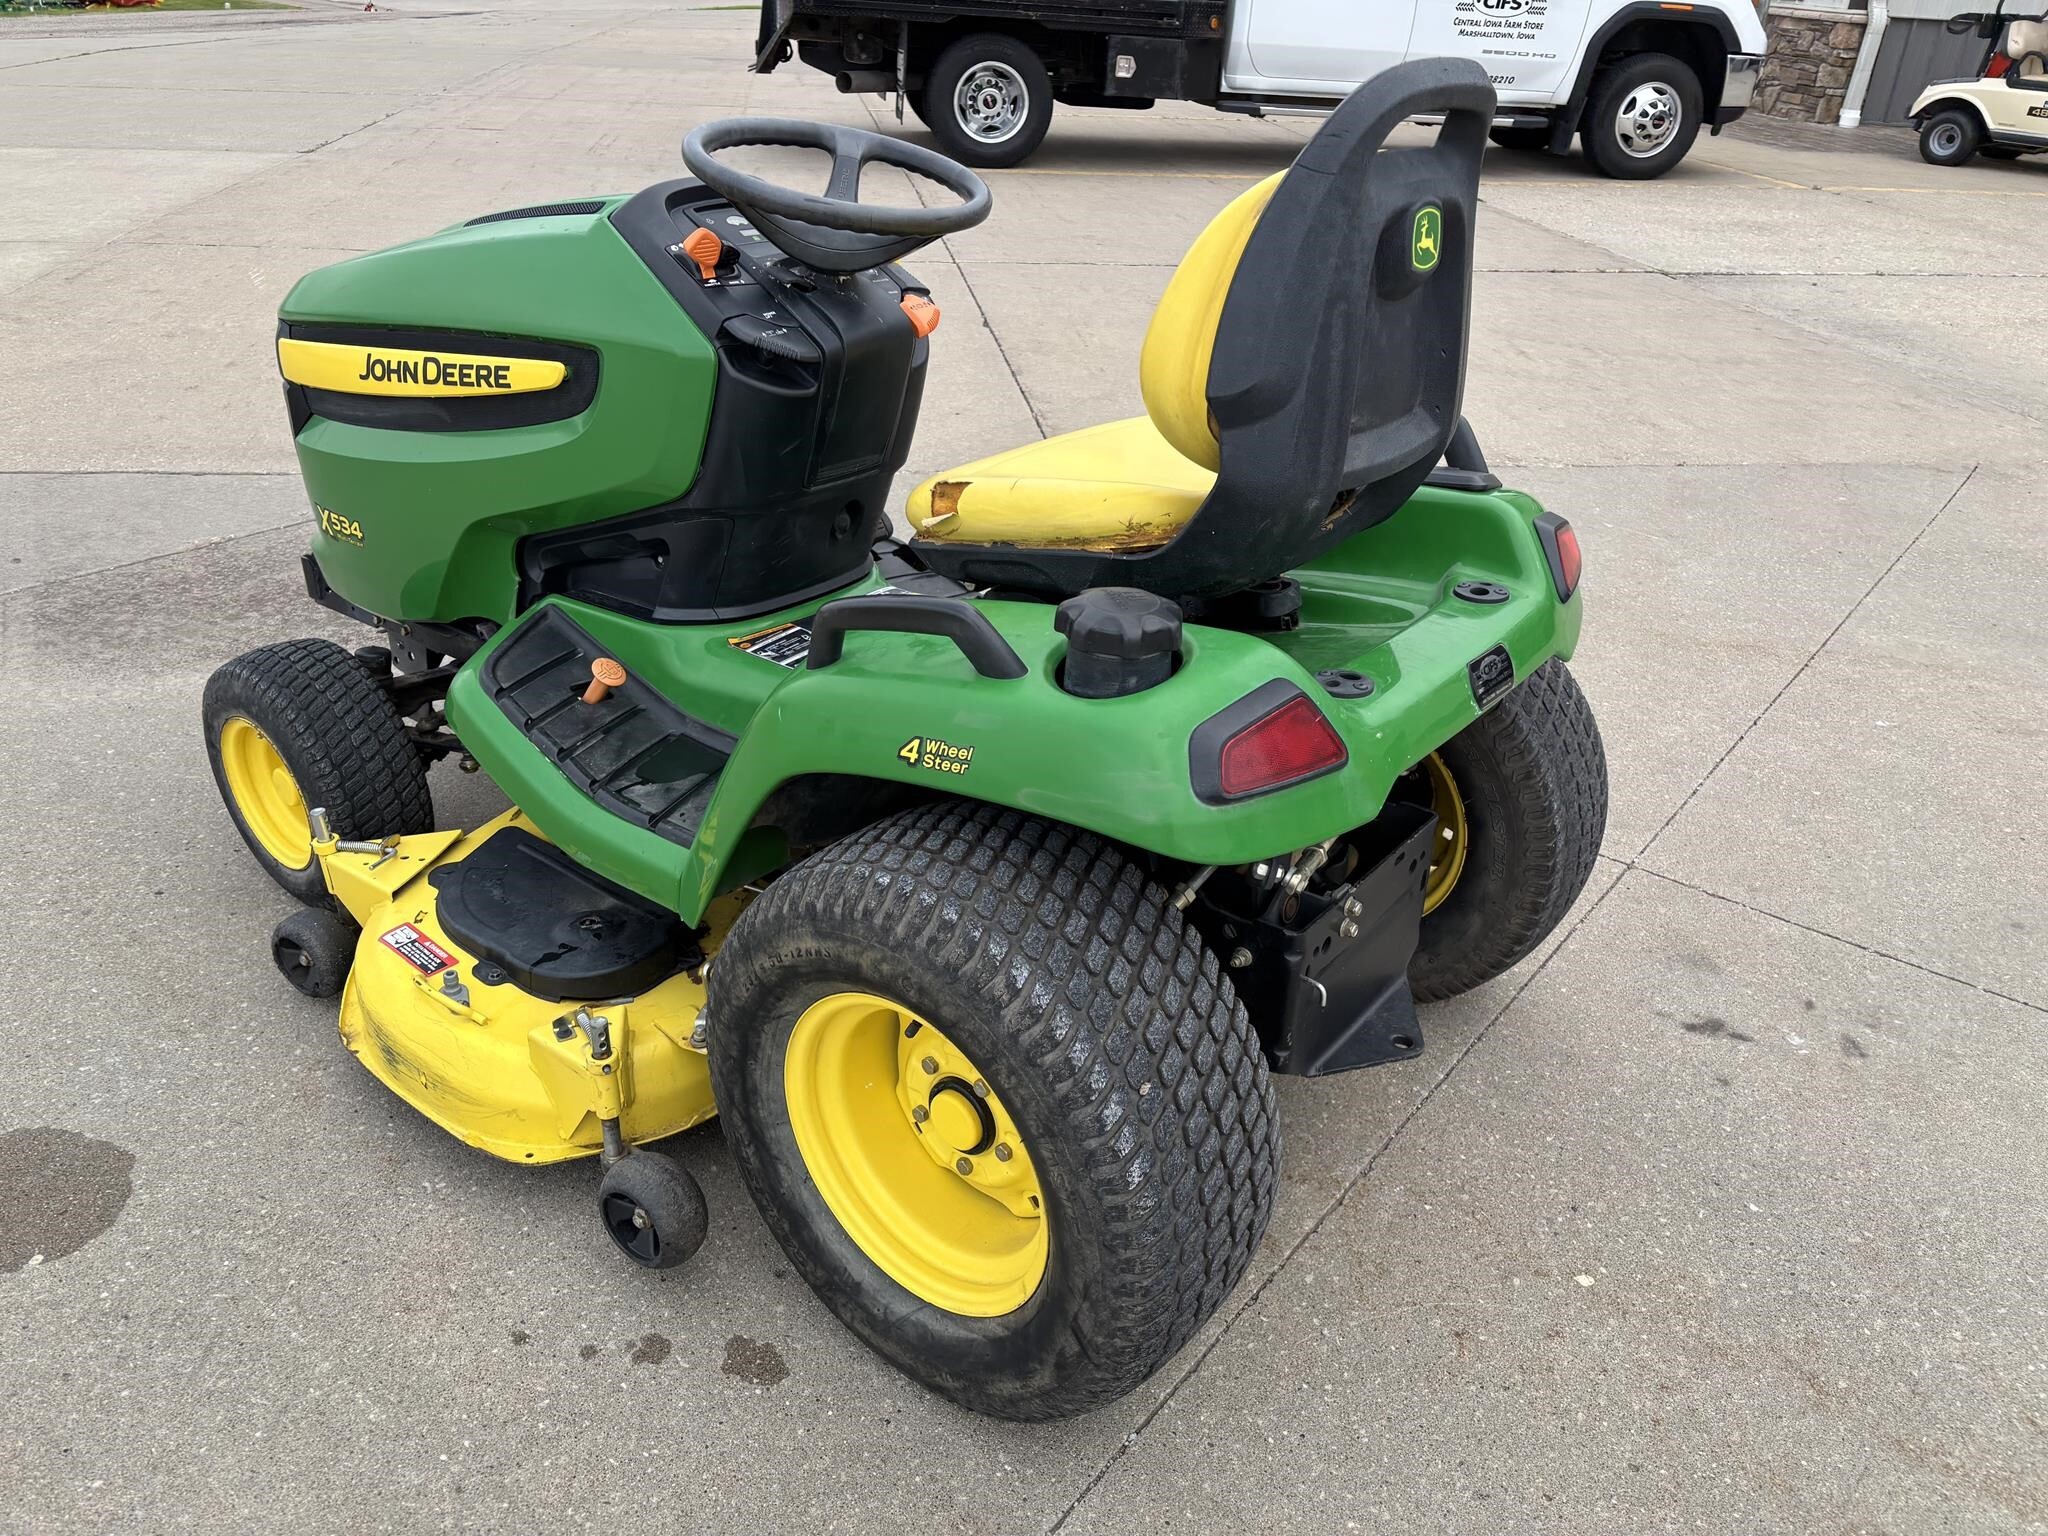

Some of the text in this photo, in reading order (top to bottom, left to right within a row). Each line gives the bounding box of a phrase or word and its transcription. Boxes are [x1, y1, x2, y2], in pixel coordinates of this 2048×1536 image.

[1483, 0, 1523, 10] CIFS
[1453, 17, 1544, 31] CENTRAL IOWA FARM STORE
[1516, 31, 1536, 40] IOWA
[359, 353, 512, 389] JOHN DEERE
[315, 503, 364, 540] X534
[899, 737, 975, 765] 4 Wheel
[922, 753, 969, 776] Steer
